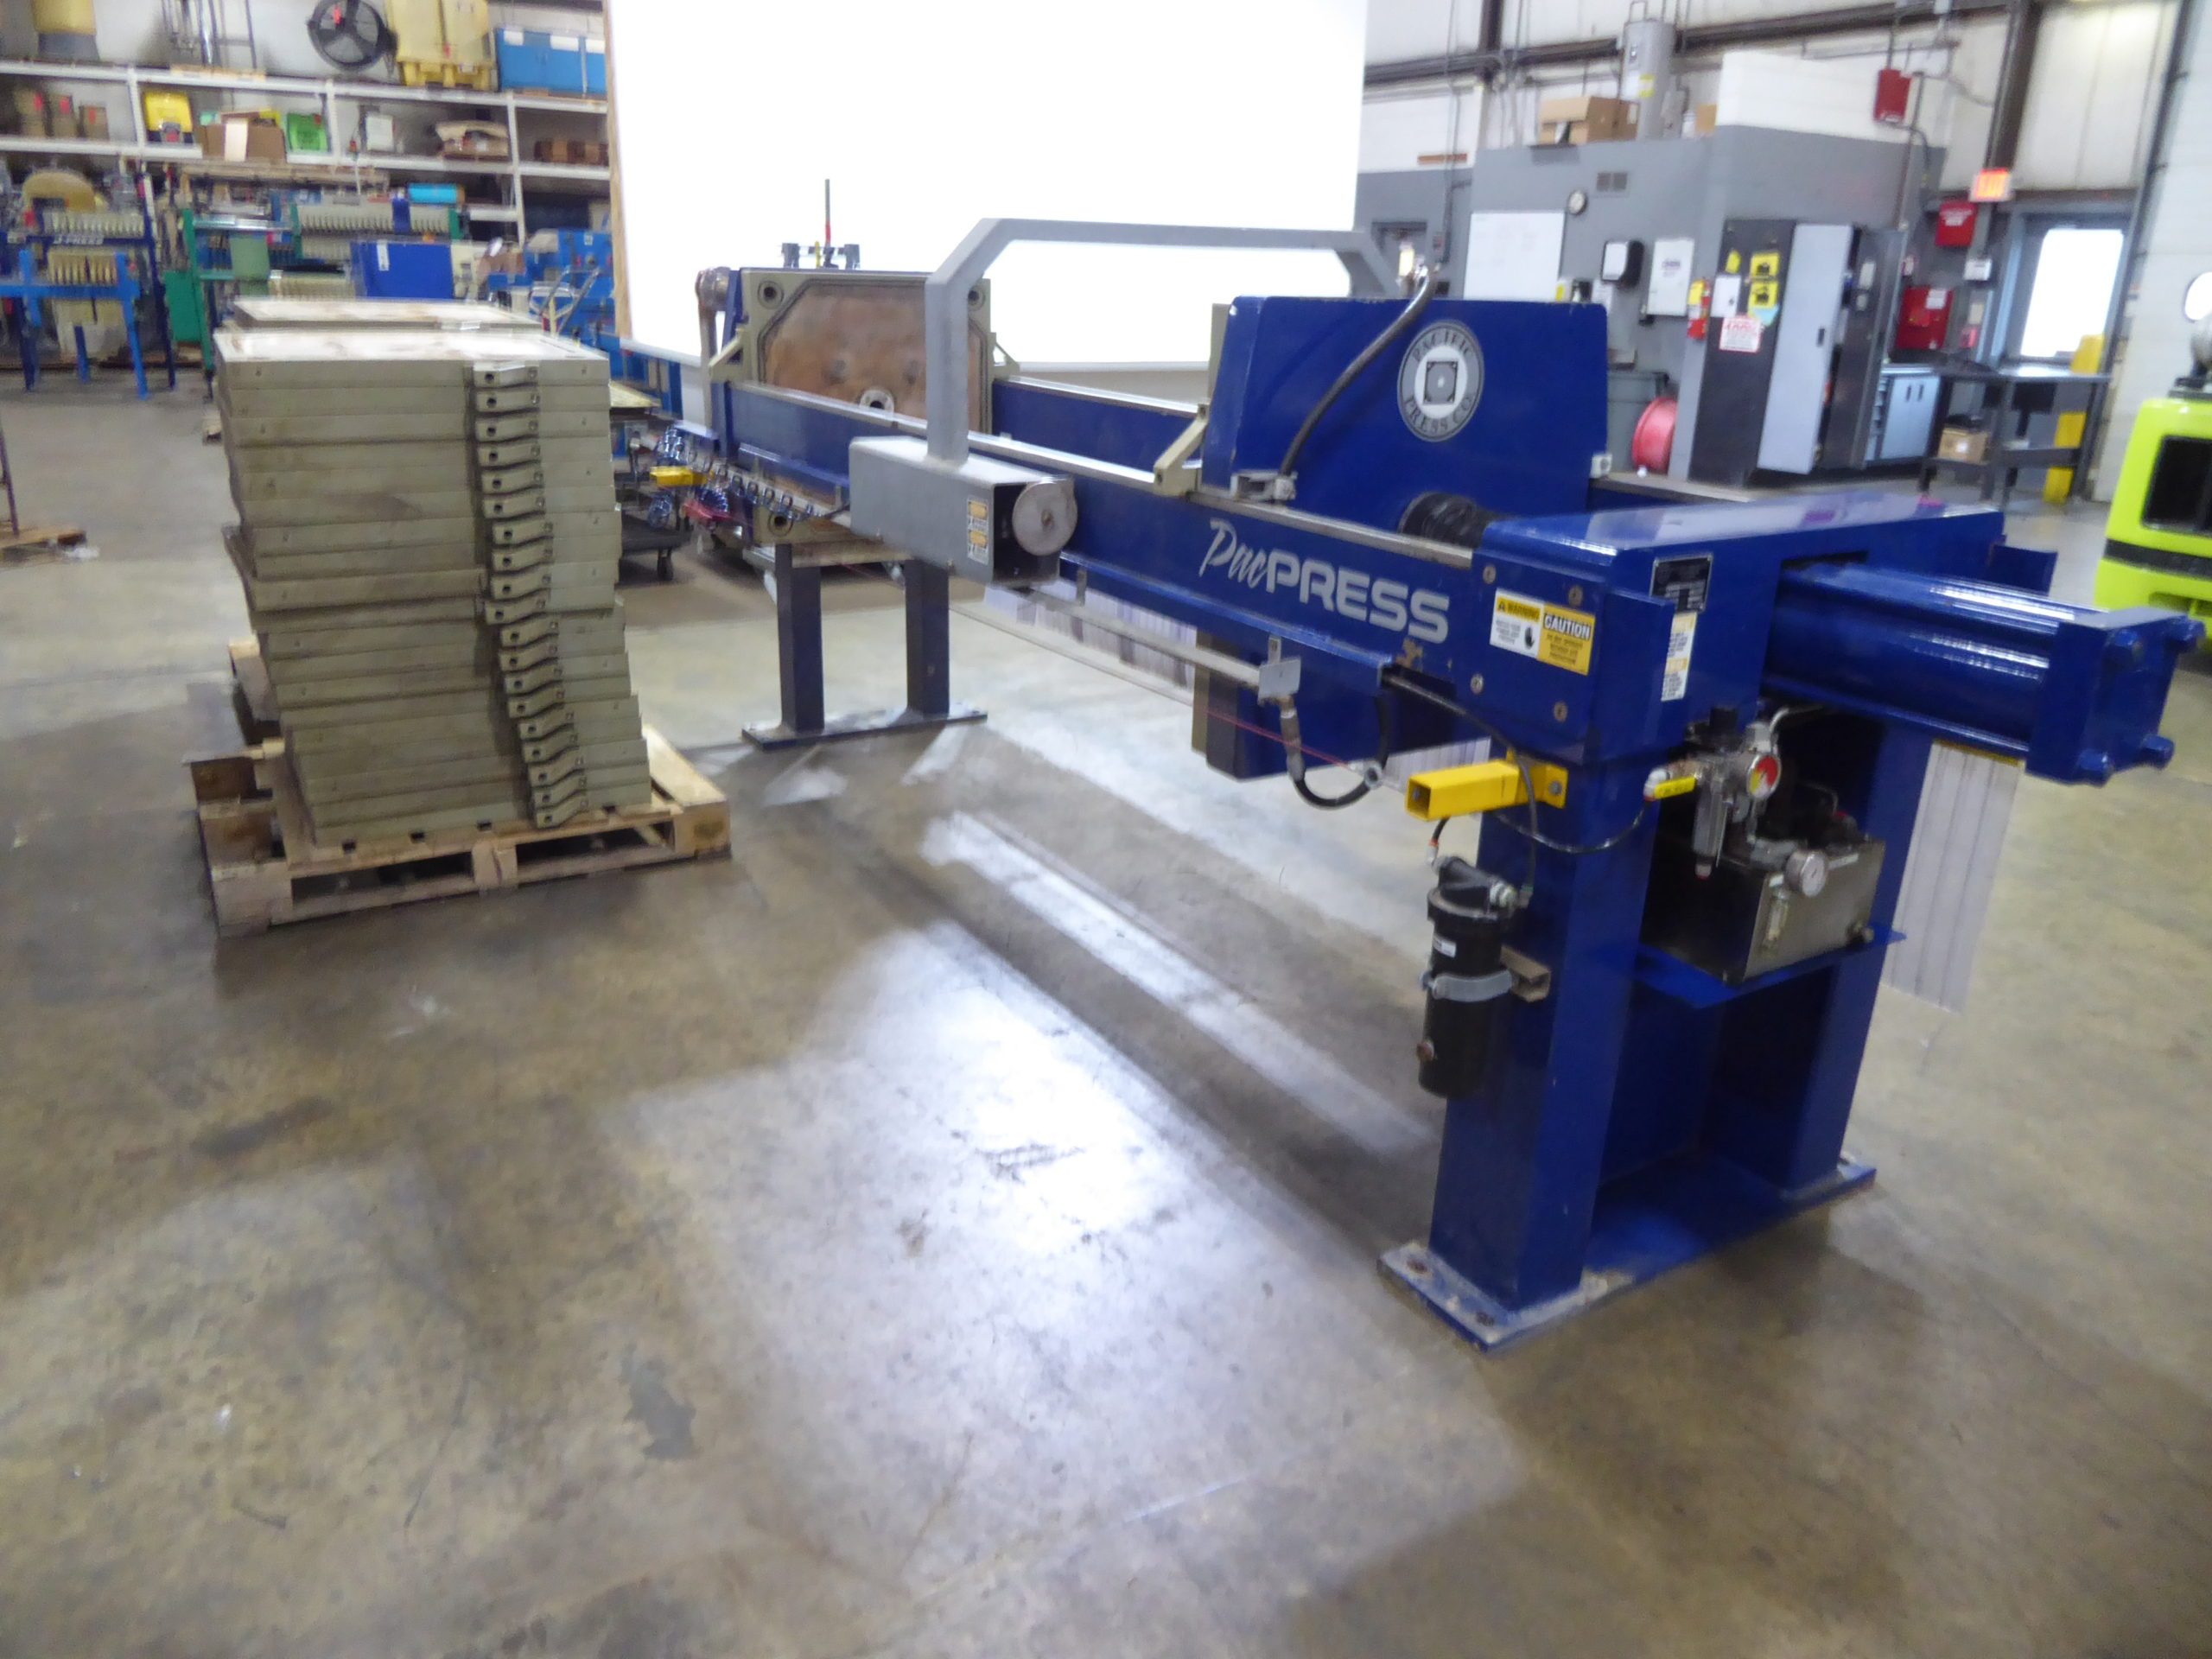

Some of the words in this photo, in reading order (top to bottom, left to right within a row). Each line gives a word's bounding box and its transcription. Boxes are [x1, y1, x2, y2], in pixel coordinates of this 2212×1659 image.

[1412, 330, 1471, 362] PACIFIC
[1404, 396, 1449, 434] PRESS
[1543, 613, 1592, 640] CAUTION
